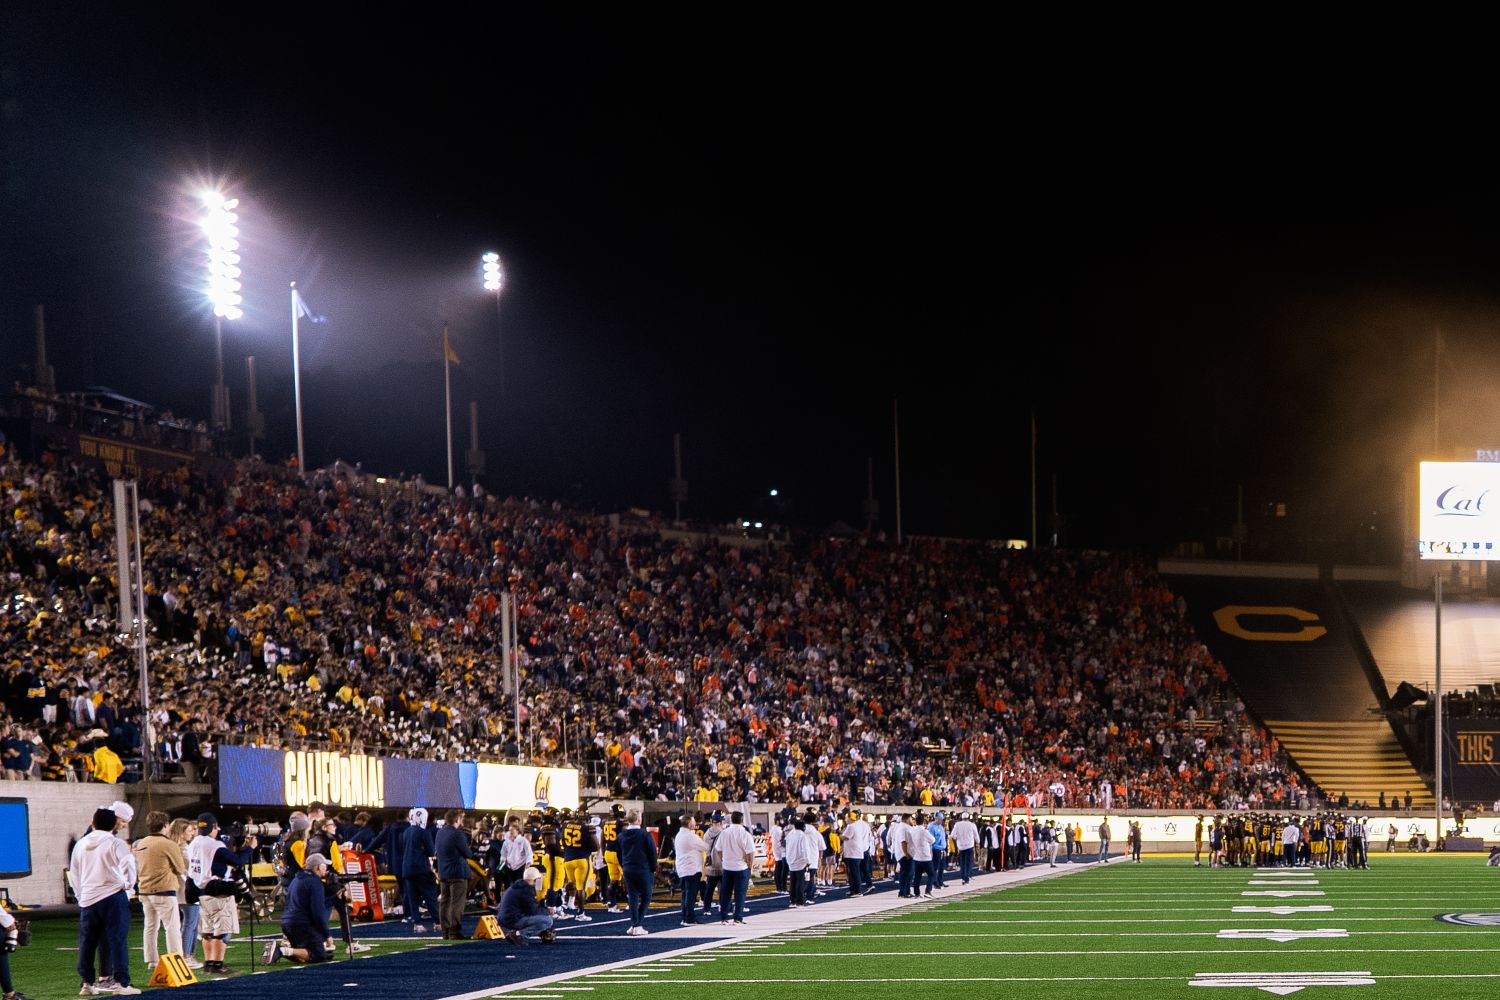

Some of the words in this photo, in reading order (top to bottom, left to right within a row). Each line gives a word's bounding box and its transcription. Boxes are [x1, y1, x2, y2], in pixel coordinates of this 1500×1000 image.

[1436, 485, 1490, 516] Cal
[1212, 605, 1327, 641] C
[1457, 735, 1493, 761] THIS
[284, 751, 384, 808] CALIFORNIA!
[535, 772, 551, 804] Cal
[564, 828, 582, 847] 52
[604, 824, 617, 841] 95
[155, 973, 169, 985] Cal
[167, 954, 192, 983] 10
